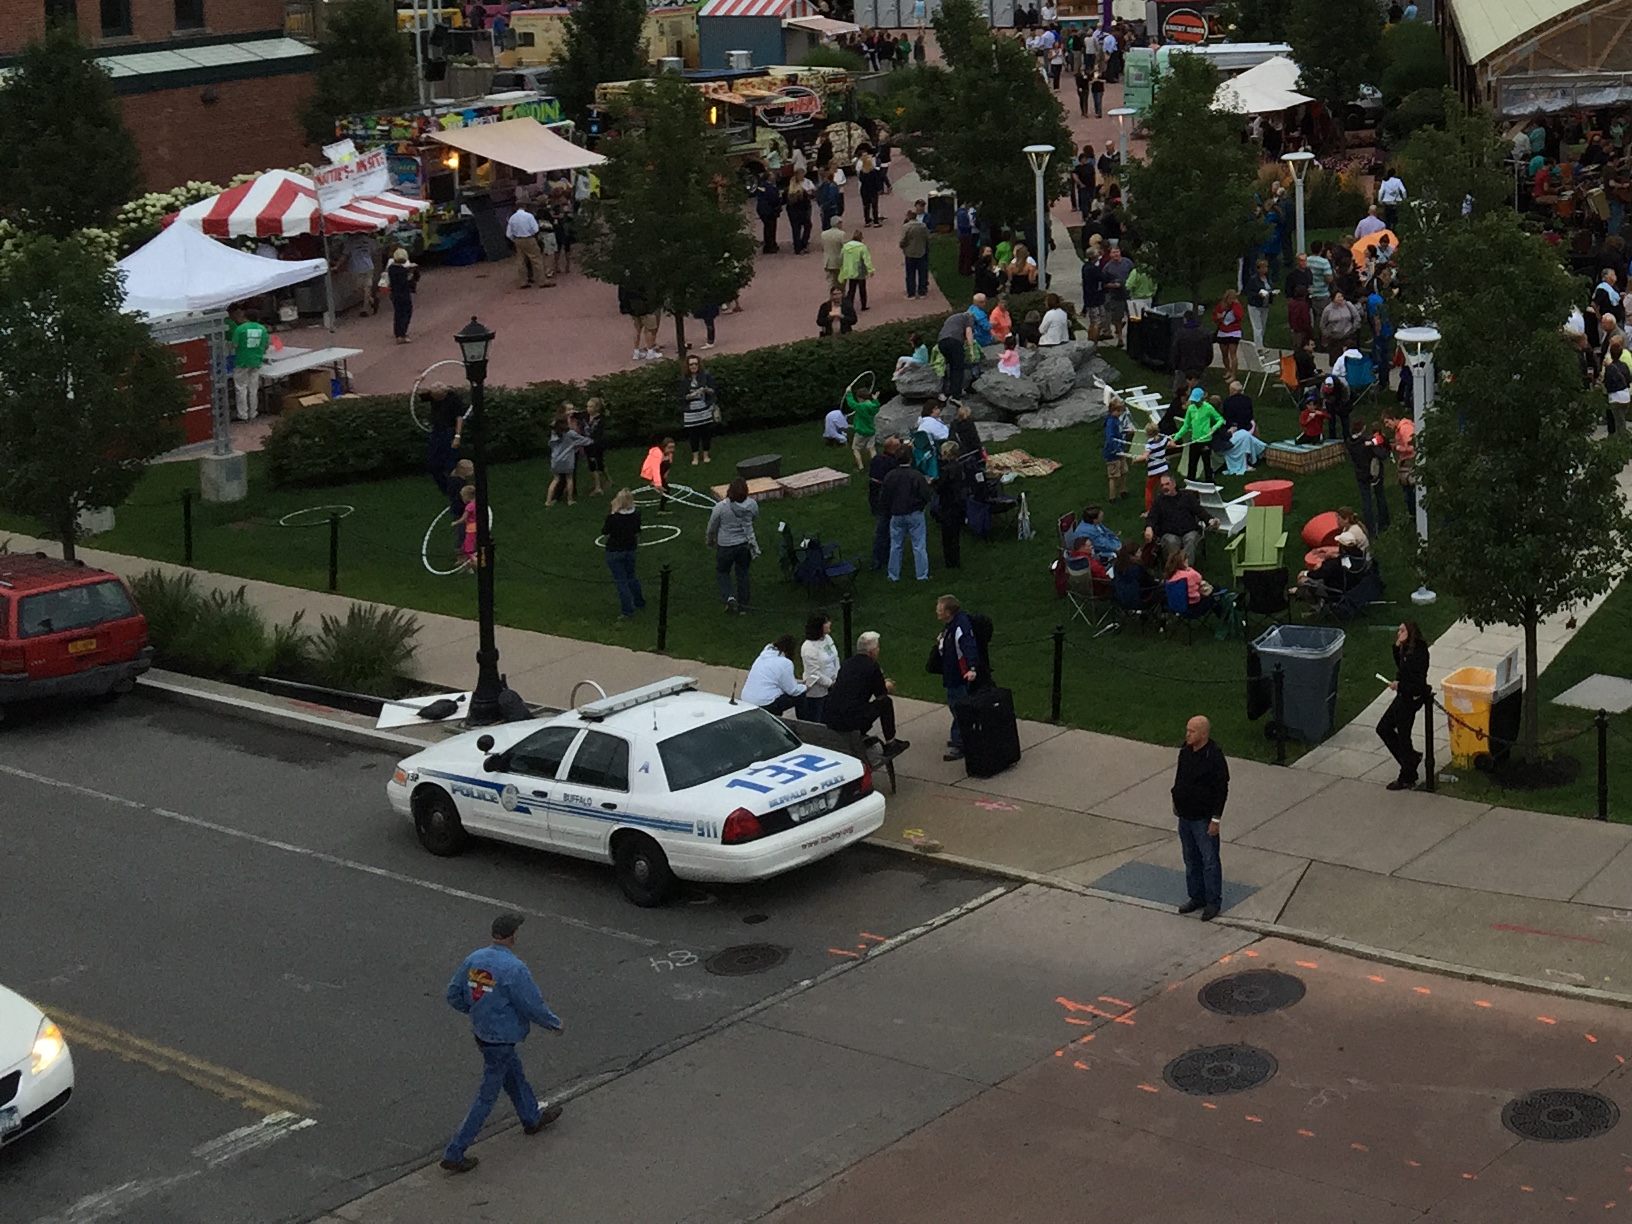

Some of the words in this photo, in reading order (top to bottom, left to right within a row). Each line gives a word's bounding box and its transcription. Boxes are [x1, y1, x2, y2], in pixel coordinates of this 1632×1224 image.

[638, 761, 650, 774] A
[726, 754, 841, 794] 132
[450, 783, 499, 804] POLICE
[563, 793, 593, 807] BUFFALO
[769, 788, 807, 808] BUFFALO
[821, 775, 845, 790] POLICE
[696, 820, 718, 838] 911
